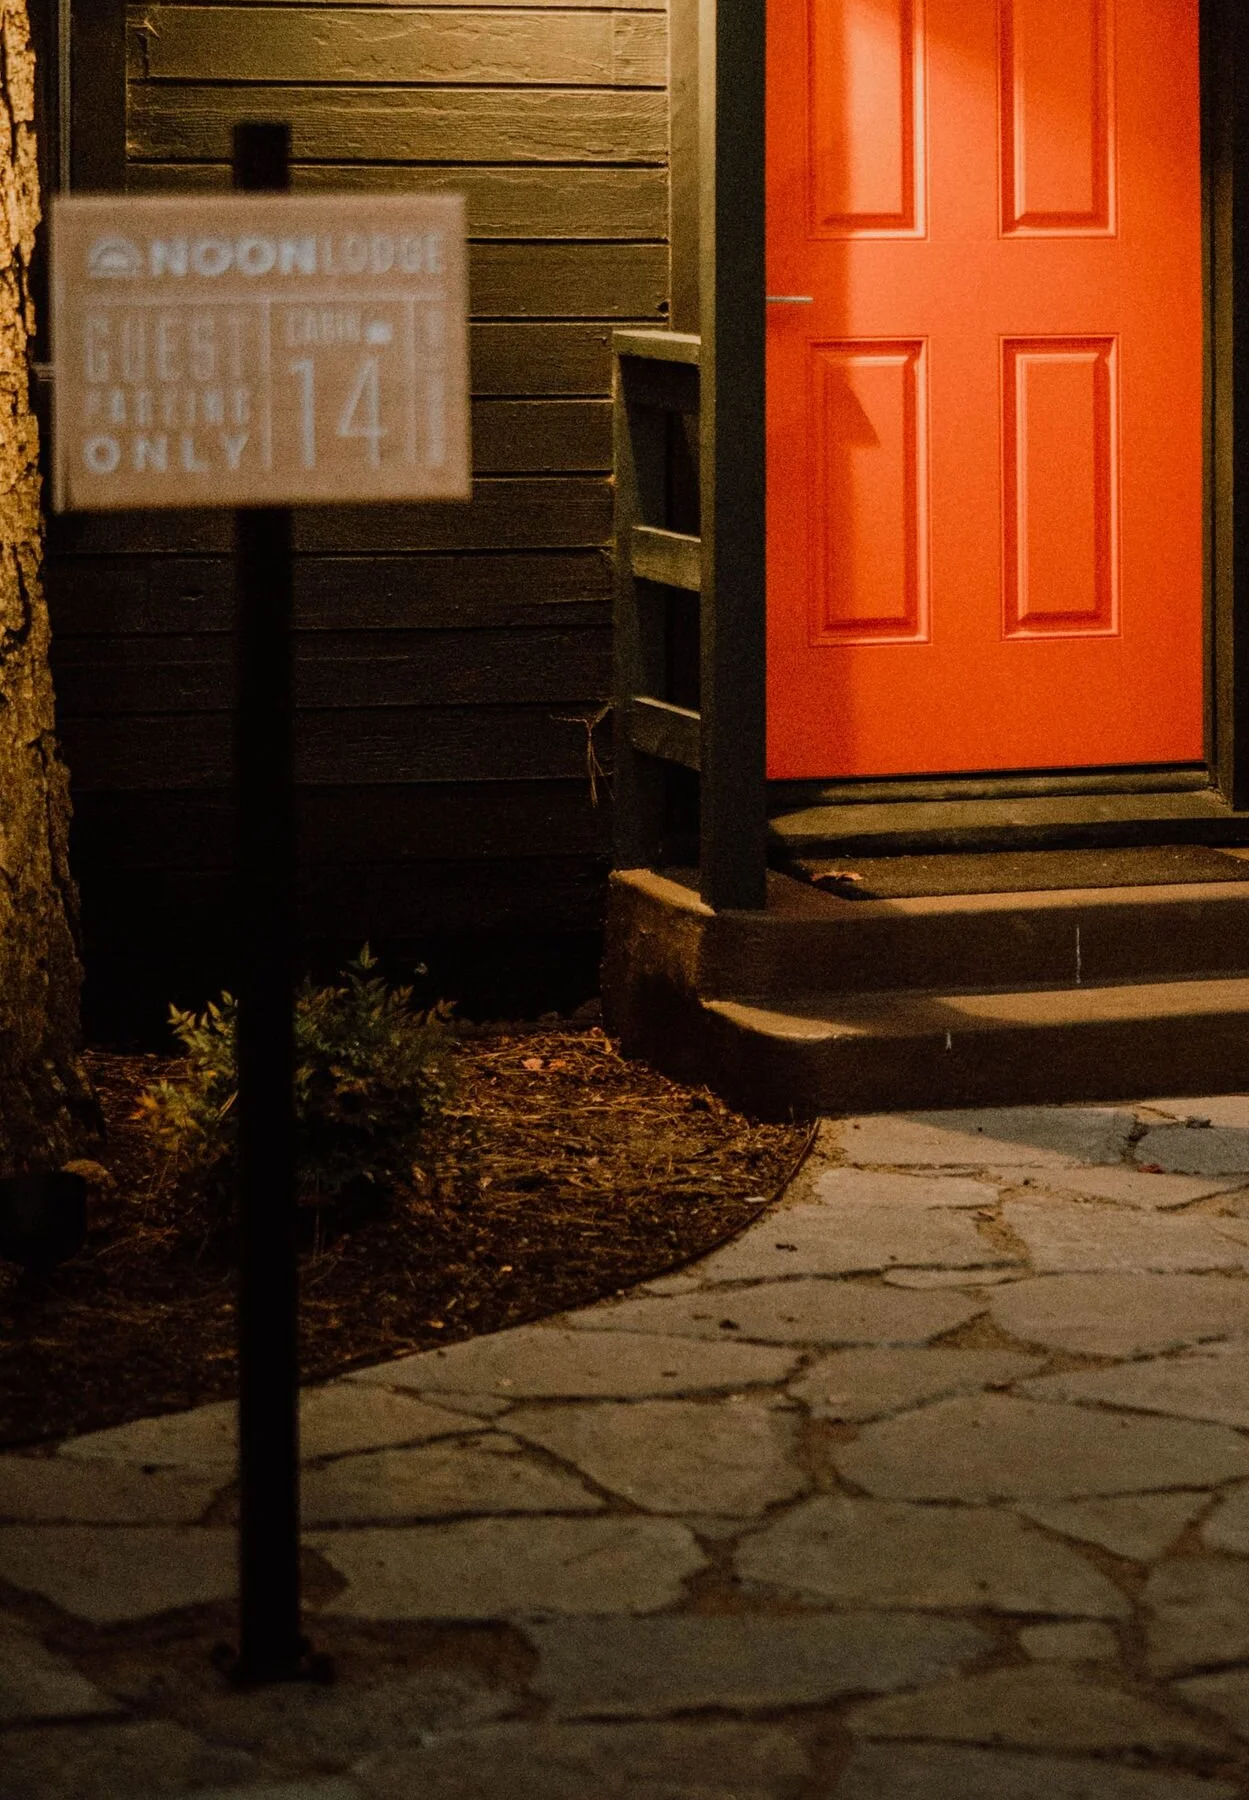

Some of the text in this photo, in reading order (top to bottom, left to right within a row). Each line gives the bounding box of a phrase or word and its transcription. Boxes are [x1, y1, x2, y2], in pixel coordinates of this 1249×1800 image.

[83, 313, 250, 384] GUEST
[288, 356, 389, 472] 14
[82, 432, 250, 475] ONLY
